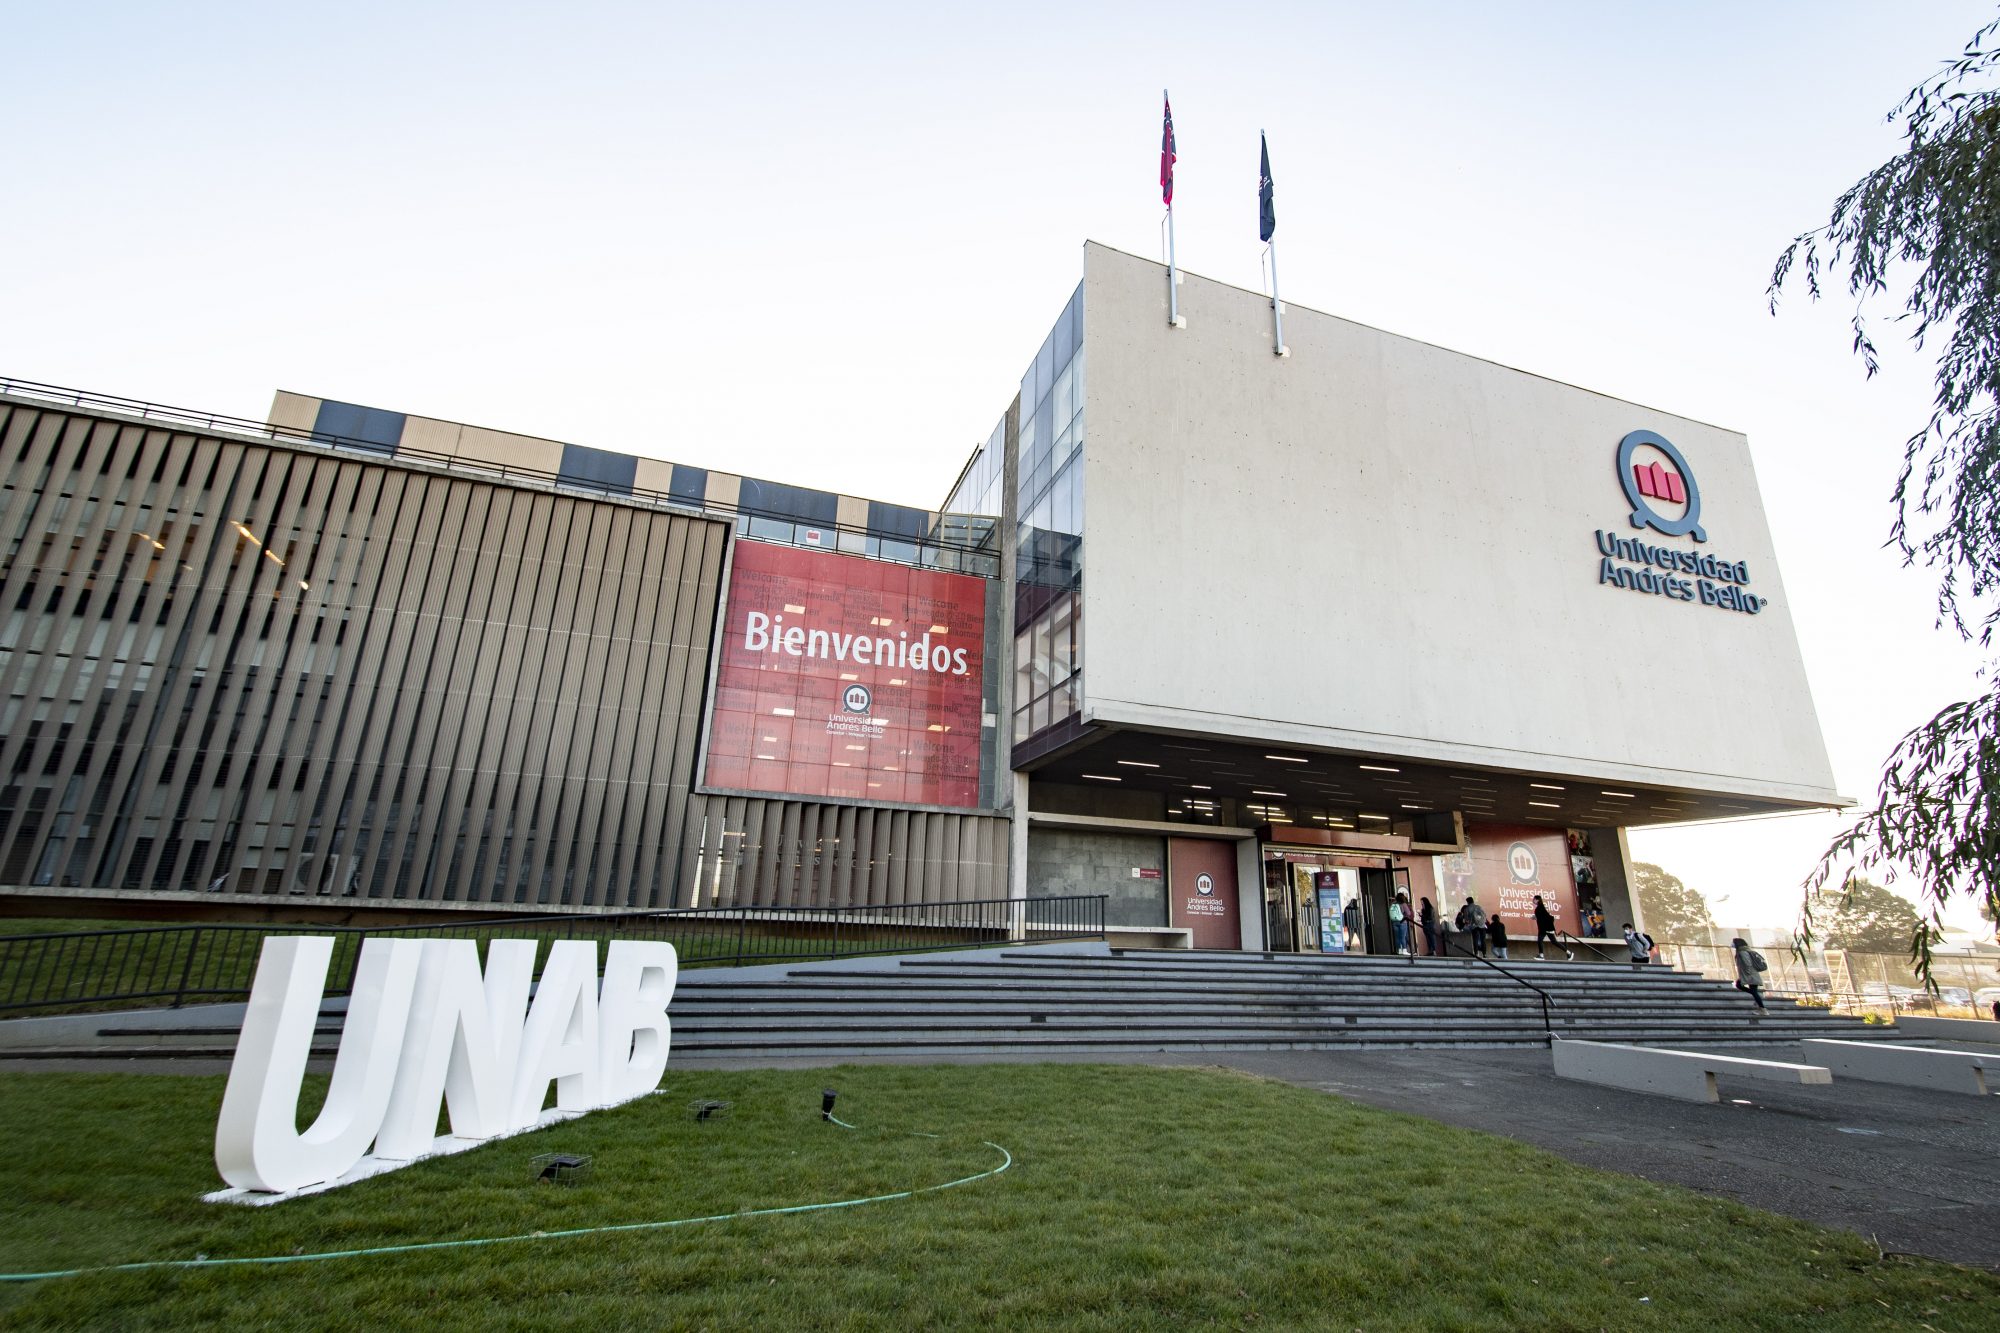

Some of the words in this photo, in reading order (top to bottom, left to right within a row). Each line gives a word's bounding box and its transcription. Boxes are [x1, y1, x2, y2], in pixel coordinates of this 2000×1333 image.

[1595, 529, 1750, 585] Universidad
[1600, 556, 1696, 602] Andrés
[744, 611, 968, 675] Bienvenidos
[827, 721, 860, 732] Andrés
[829, 714, 883, 726] Universid
[1498, 887, 1556, 900] Universidad
[1187, 897, 1223, 906] Universidad
[1187, 903, 1209, 911] Andrés
[1499, 897, 1534, 911] Andrés
[1543, 900, 1561, 912] ello
[215, 936, 678, 1193] UNAB
